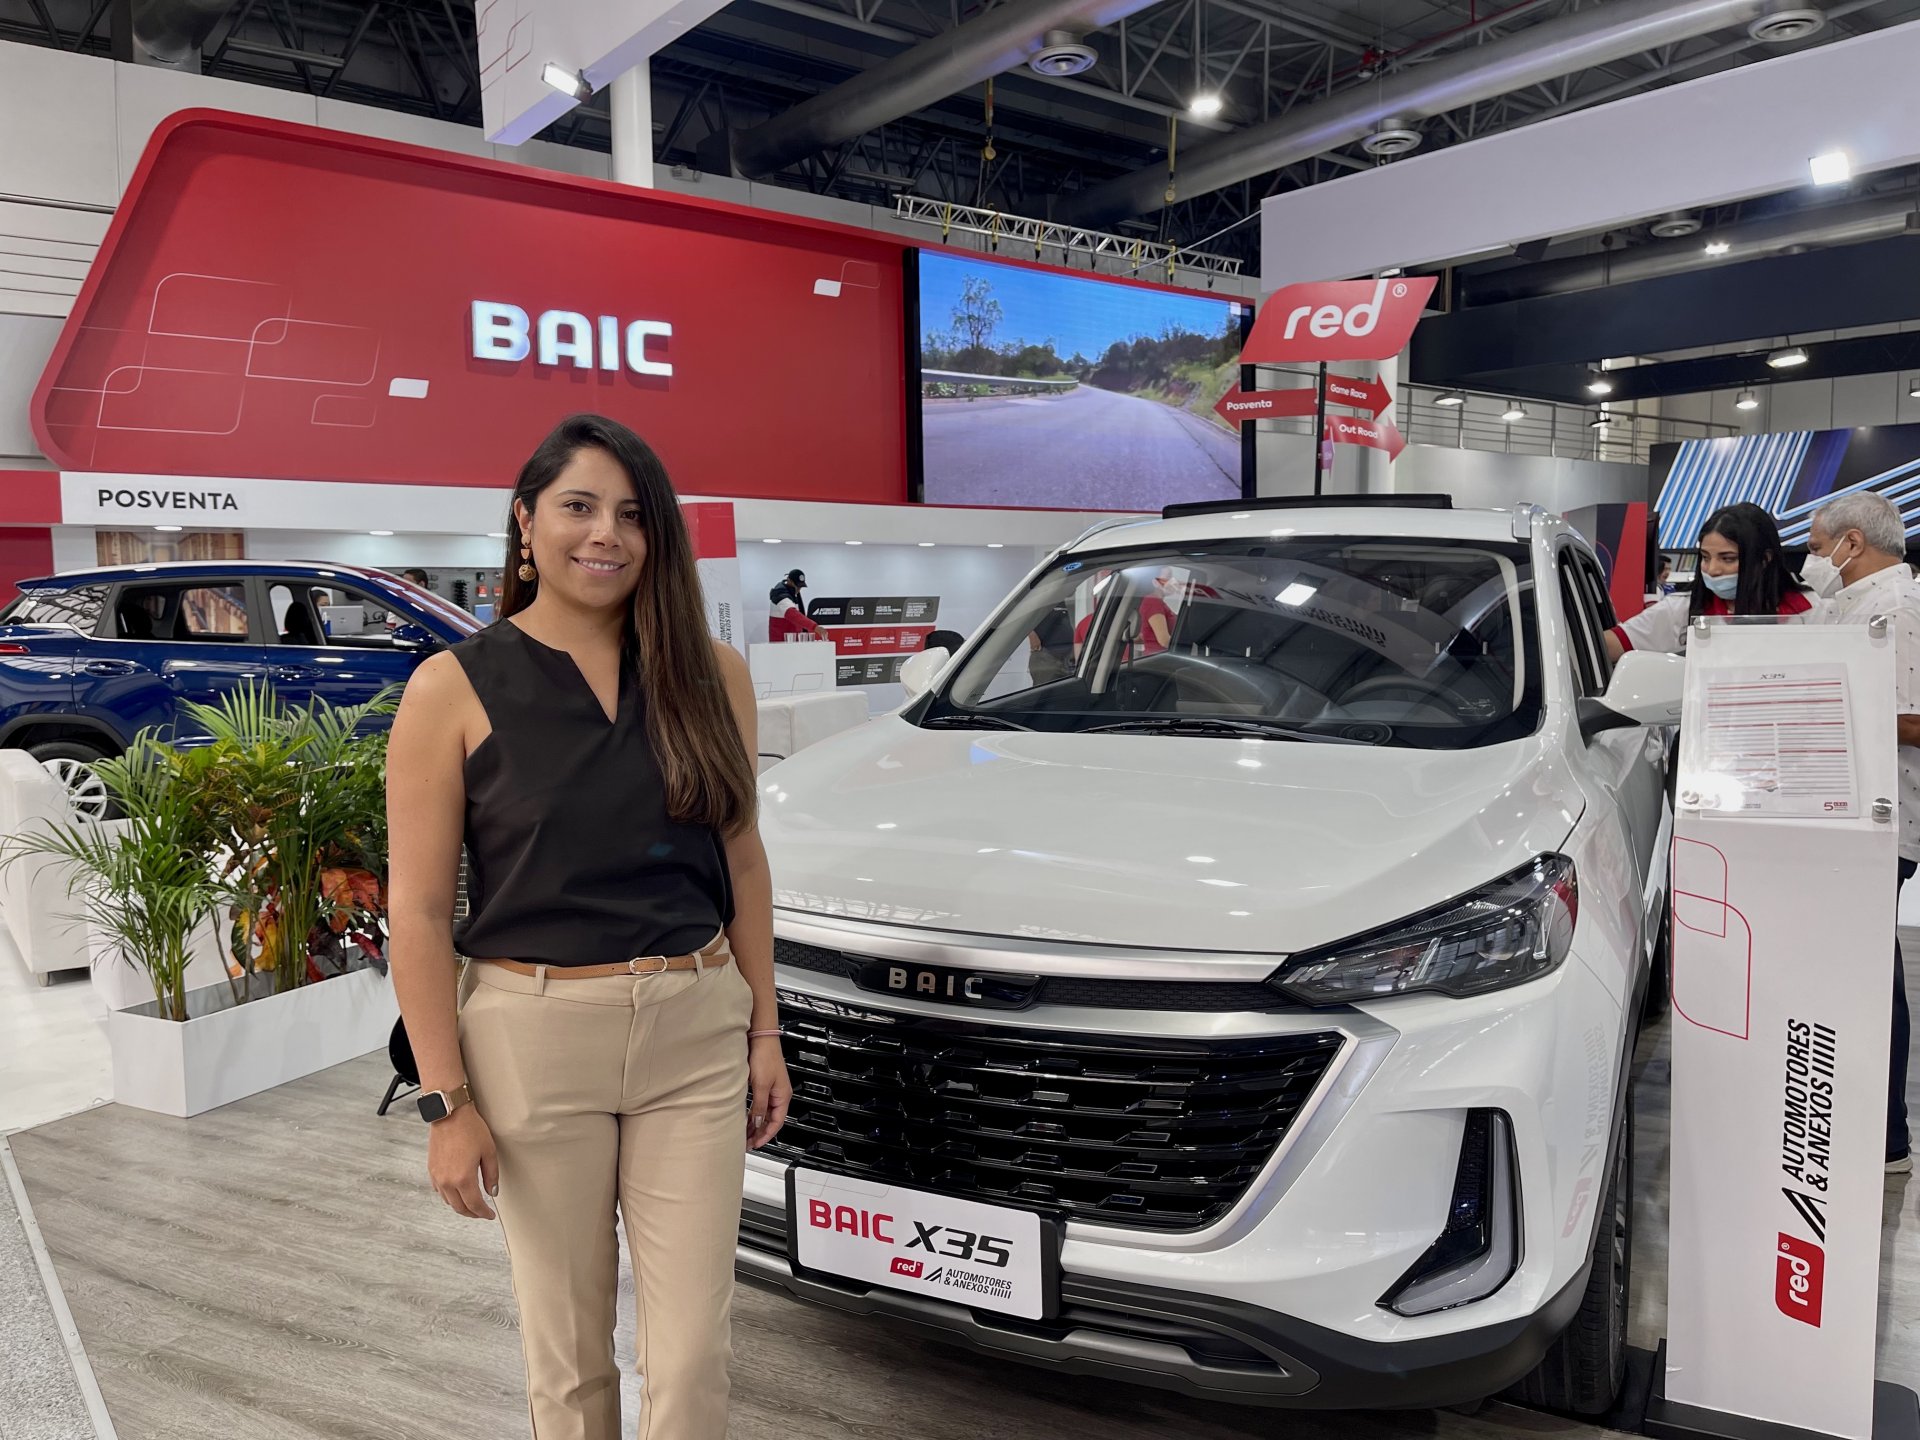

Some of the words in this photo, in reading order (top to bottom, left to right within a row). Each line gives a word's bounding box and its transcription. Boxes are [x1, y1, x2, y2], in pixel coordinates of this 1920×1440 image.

[471, 300, 674, 377] BAIC
[1330, 383, 1349, 396] Game
[1350, 387, 1368, 400] Race
[1226, 399, 1273, 412] Posventa
[1338, 423, 1357, 435] Out
[1357, 426, 1378, 438] Road
[98, 489, 238, 511] POSVENTA
[887, 966, 984, 1000] BAIC
[1781, 1018, 1811, 1183] AUTOMOTORES
[1807, 1077, 1834, 1172] ANEXOS
[1805, 1173, 1829, 1192] &
[809, 1198, 895, 1244] BAIC
[904, 1220, 1013, 1268] X35
[943, 1276, 952, 1286] &
[952, 1279, 990, 1294] ANEXOS
[945, 1268, 1012, 1290] AUTOMOTORES
